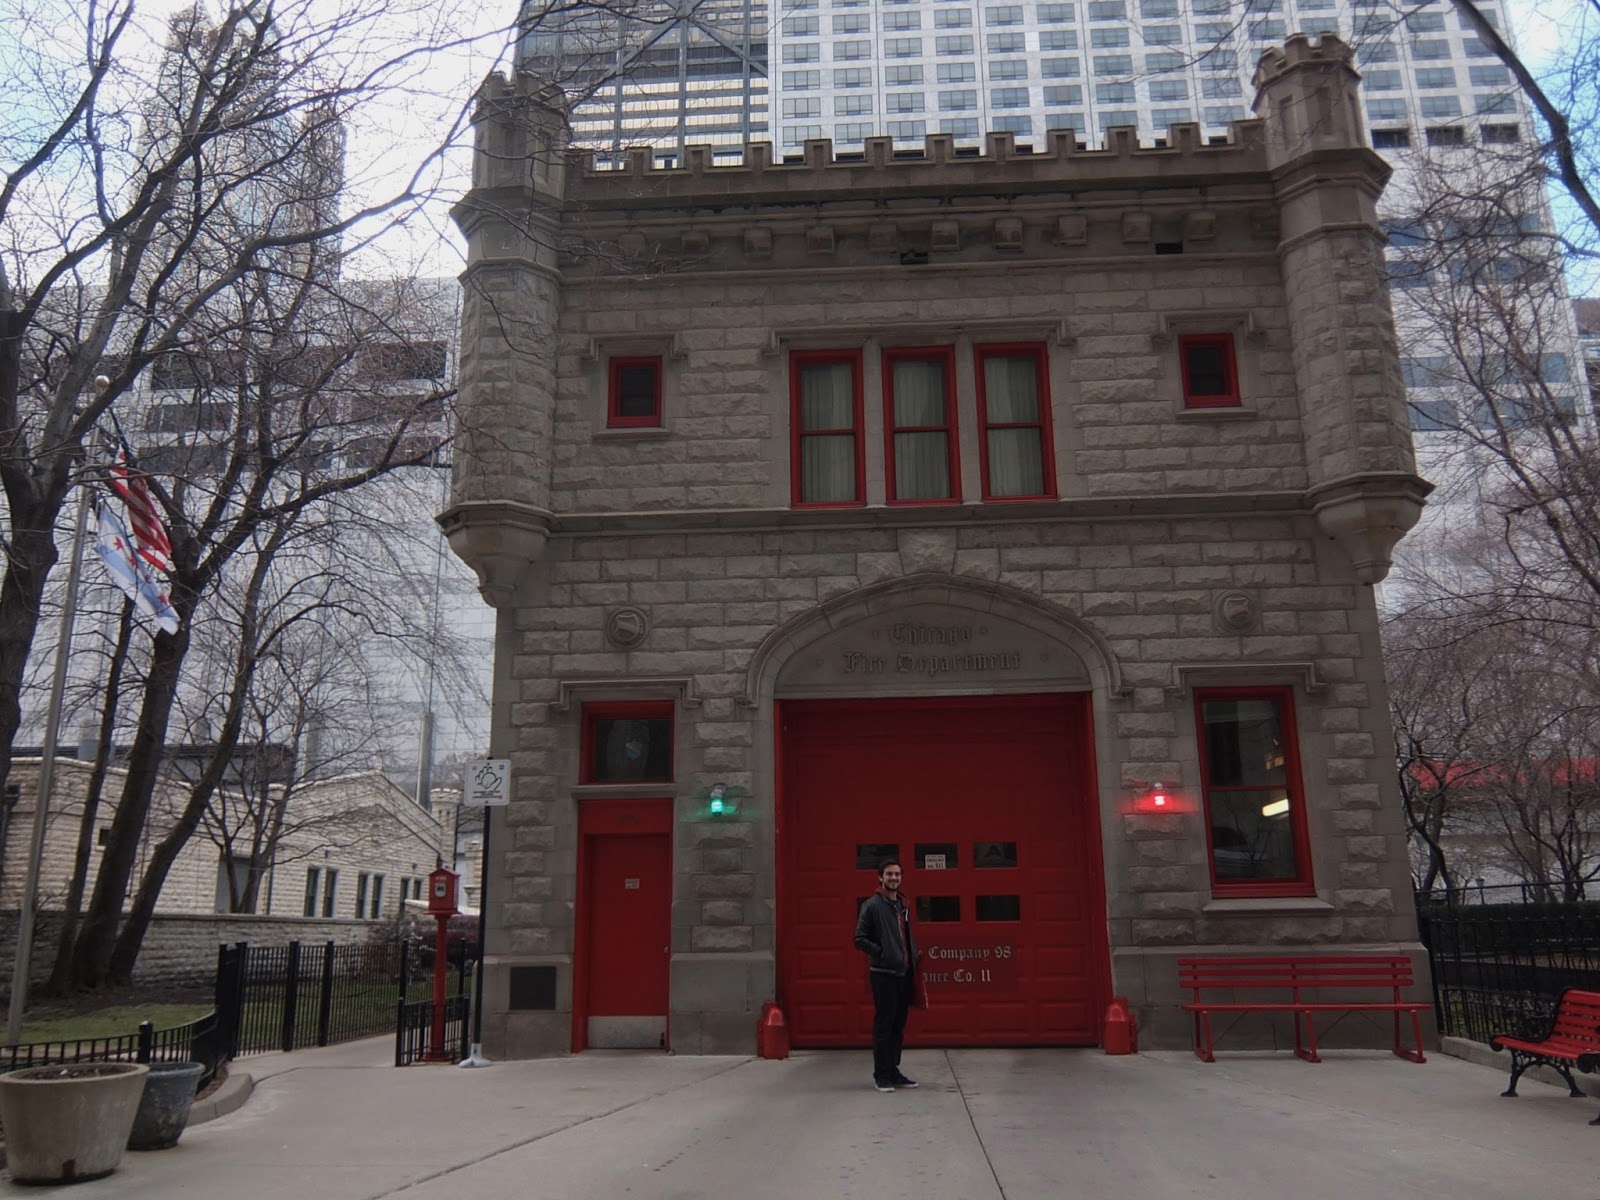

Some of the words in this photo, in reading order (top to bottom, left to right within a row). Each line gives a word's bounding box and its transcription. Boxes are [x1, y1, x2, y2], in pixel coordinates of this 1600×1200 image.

[888, 623, 971, 645] Chicago
[843, 651, 886, 673] Fire
[896, 650, 1021, 676] Department
[928, 945, 990, 961] Company
[994, 945, 1012, 959] 98
[953, 968, 976, 983] Co.
